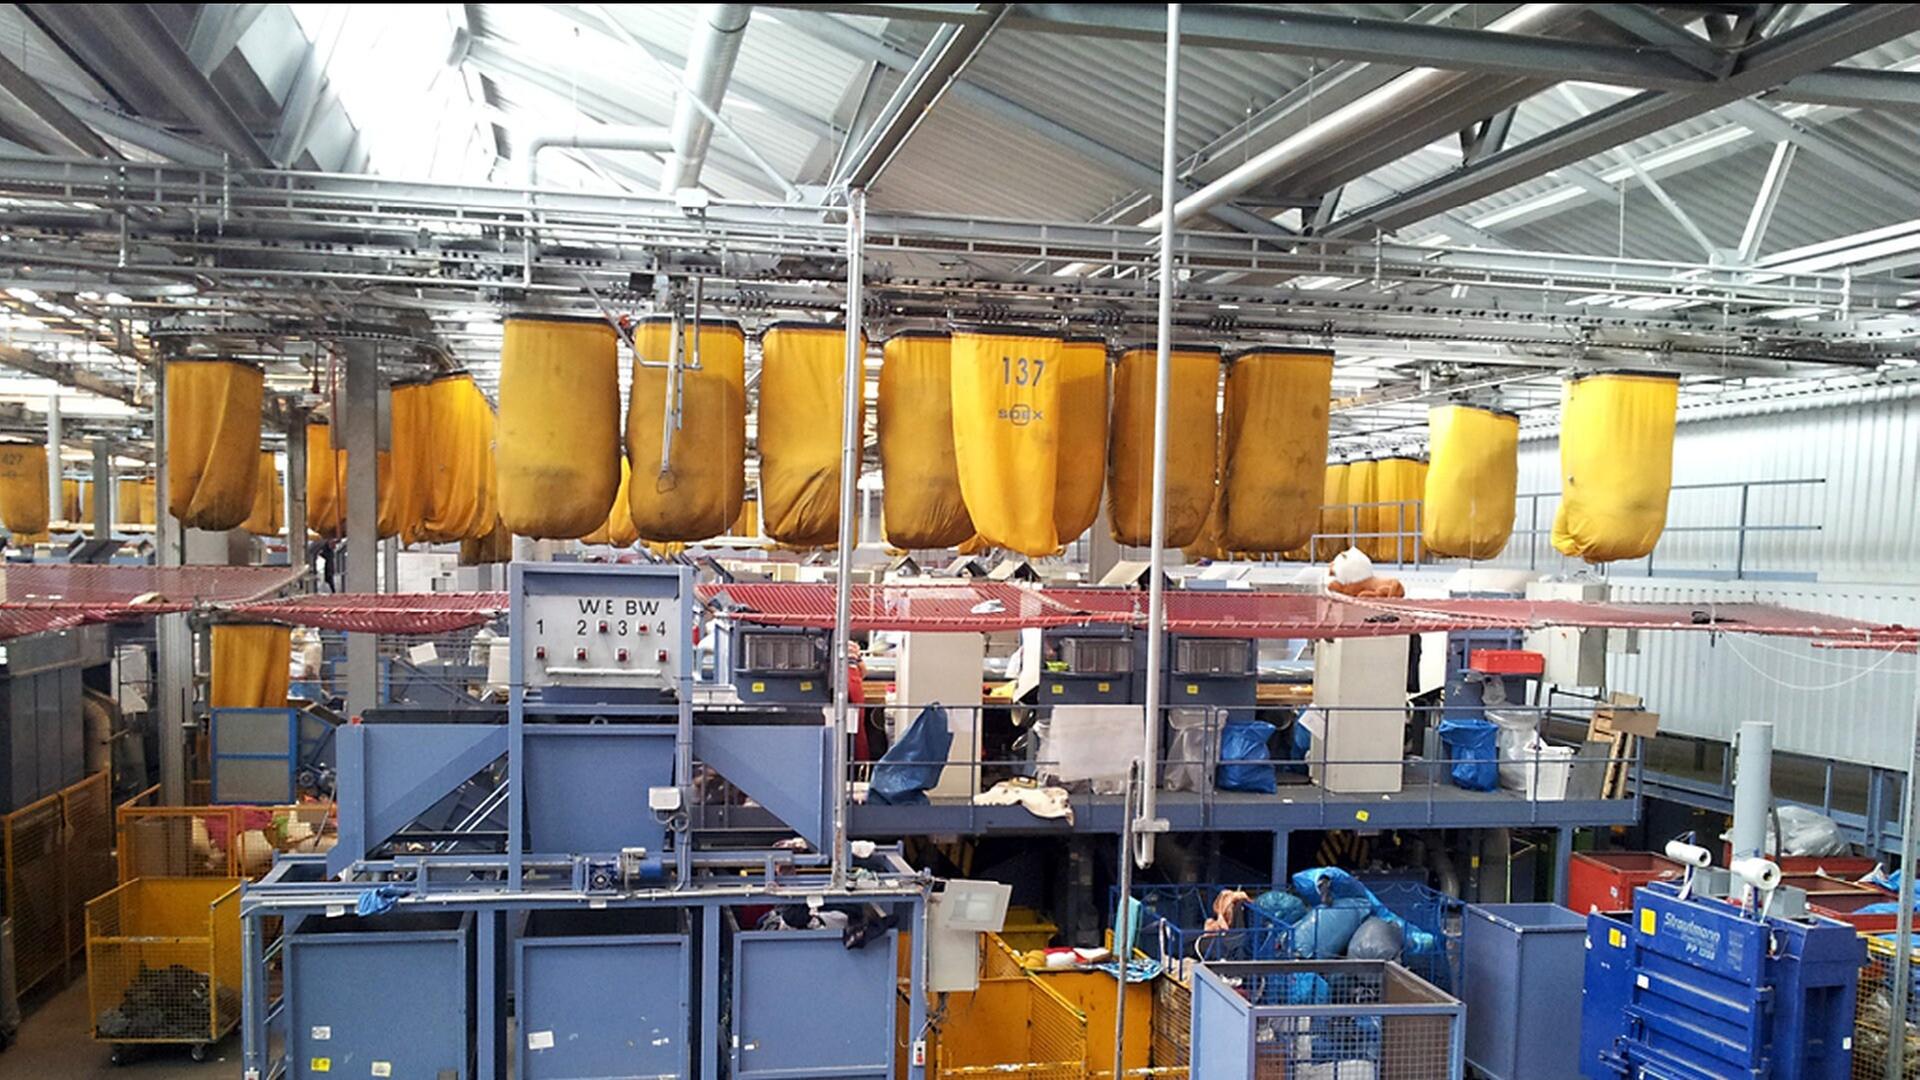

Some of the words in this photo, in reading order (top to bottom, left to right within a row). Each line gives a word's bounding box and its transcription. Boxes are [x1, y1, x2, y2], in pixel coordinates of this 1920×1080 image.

[1003, 356, 1044, 387] 137
[626, 600, 660, 616] BW
[536, 619, 544, 635] 1
[577, 620, 587, 636] 2
[618, 620, 628, 636] 3
[656, 621, 667, 636] 4
